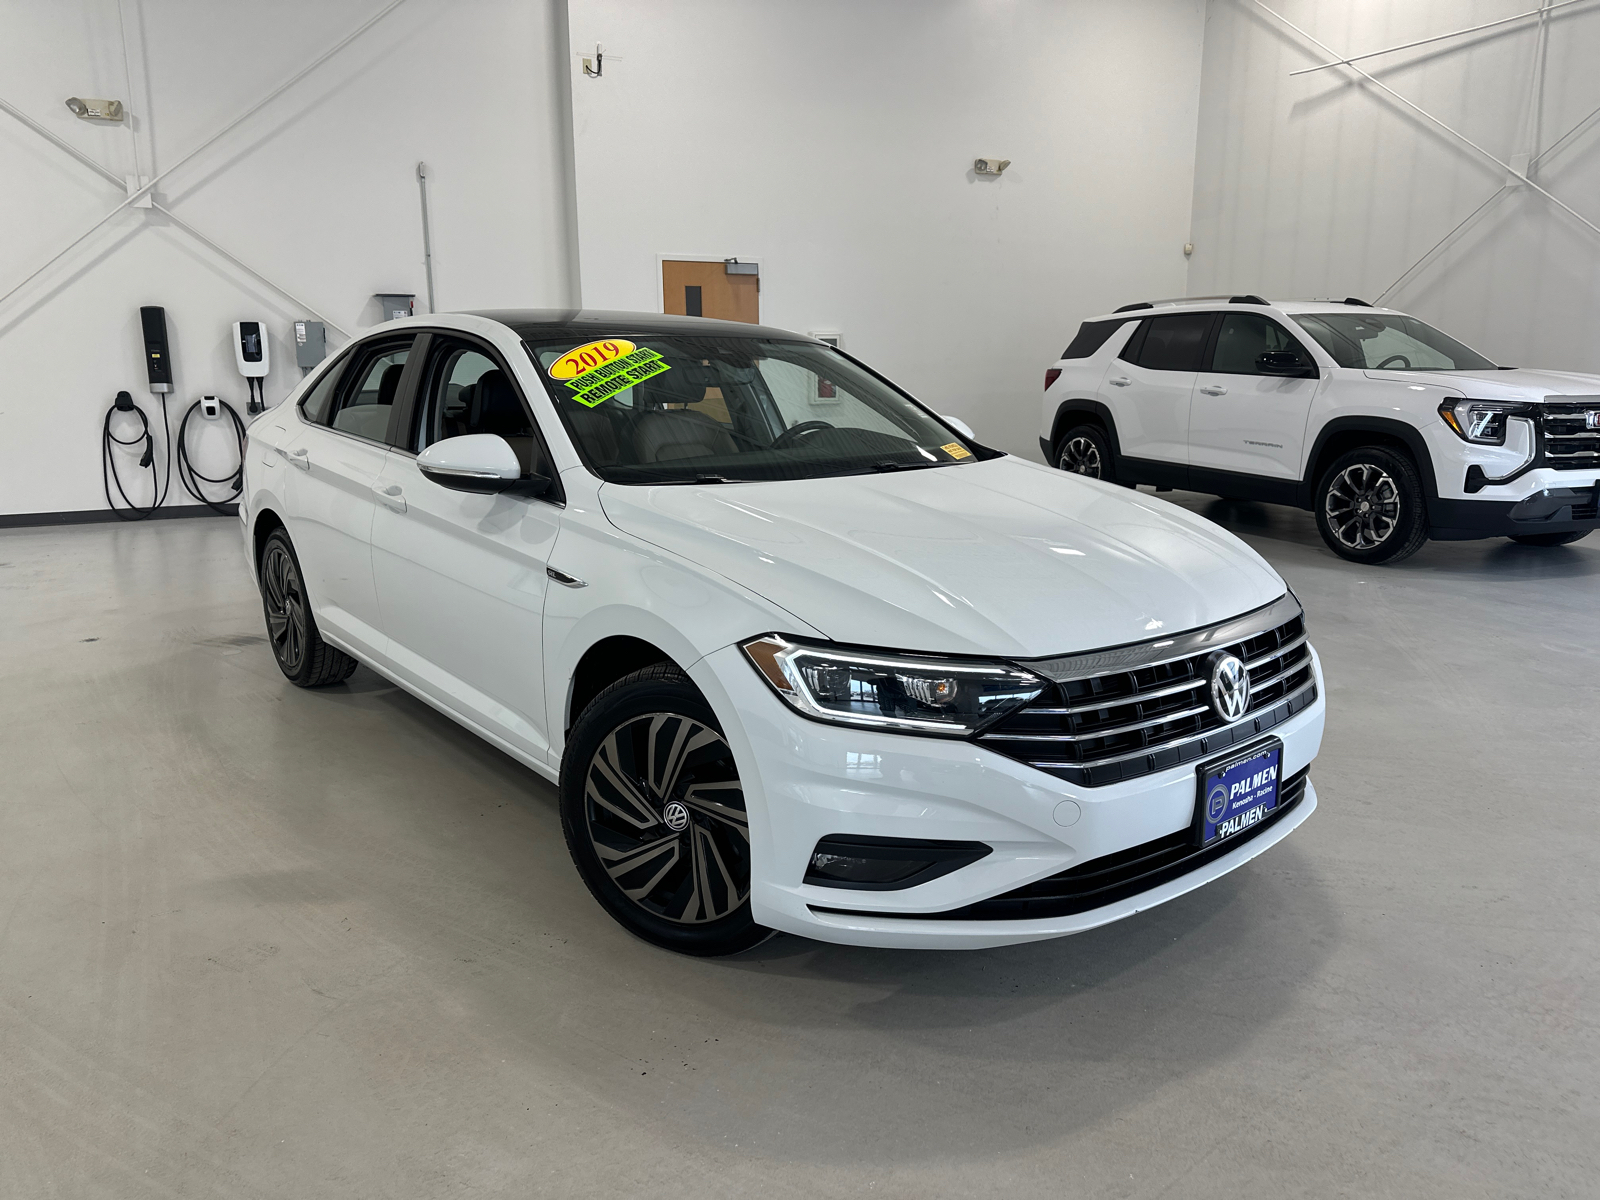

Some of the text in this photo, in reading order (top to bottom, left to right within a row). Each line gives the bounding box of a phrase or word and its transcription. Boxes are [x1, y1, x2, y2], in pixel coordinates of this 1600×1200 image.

[566, 342, 620, 376] 2019
[570, 349, 658, 391] PUSH BUTTON START
[580, 361, 664, 404] REMOTE START
[1243, 440, 1283, 449] TERRAIN
[1225, 750, 1267, 772] palmen.com
[1230, 764, 1278, 800] PALMEN
[1232, 795, 1253, 809] Kenosha
[1257, 786, 1273, 798] Racine
[1221, 805, 1263, 838] PALMEN
